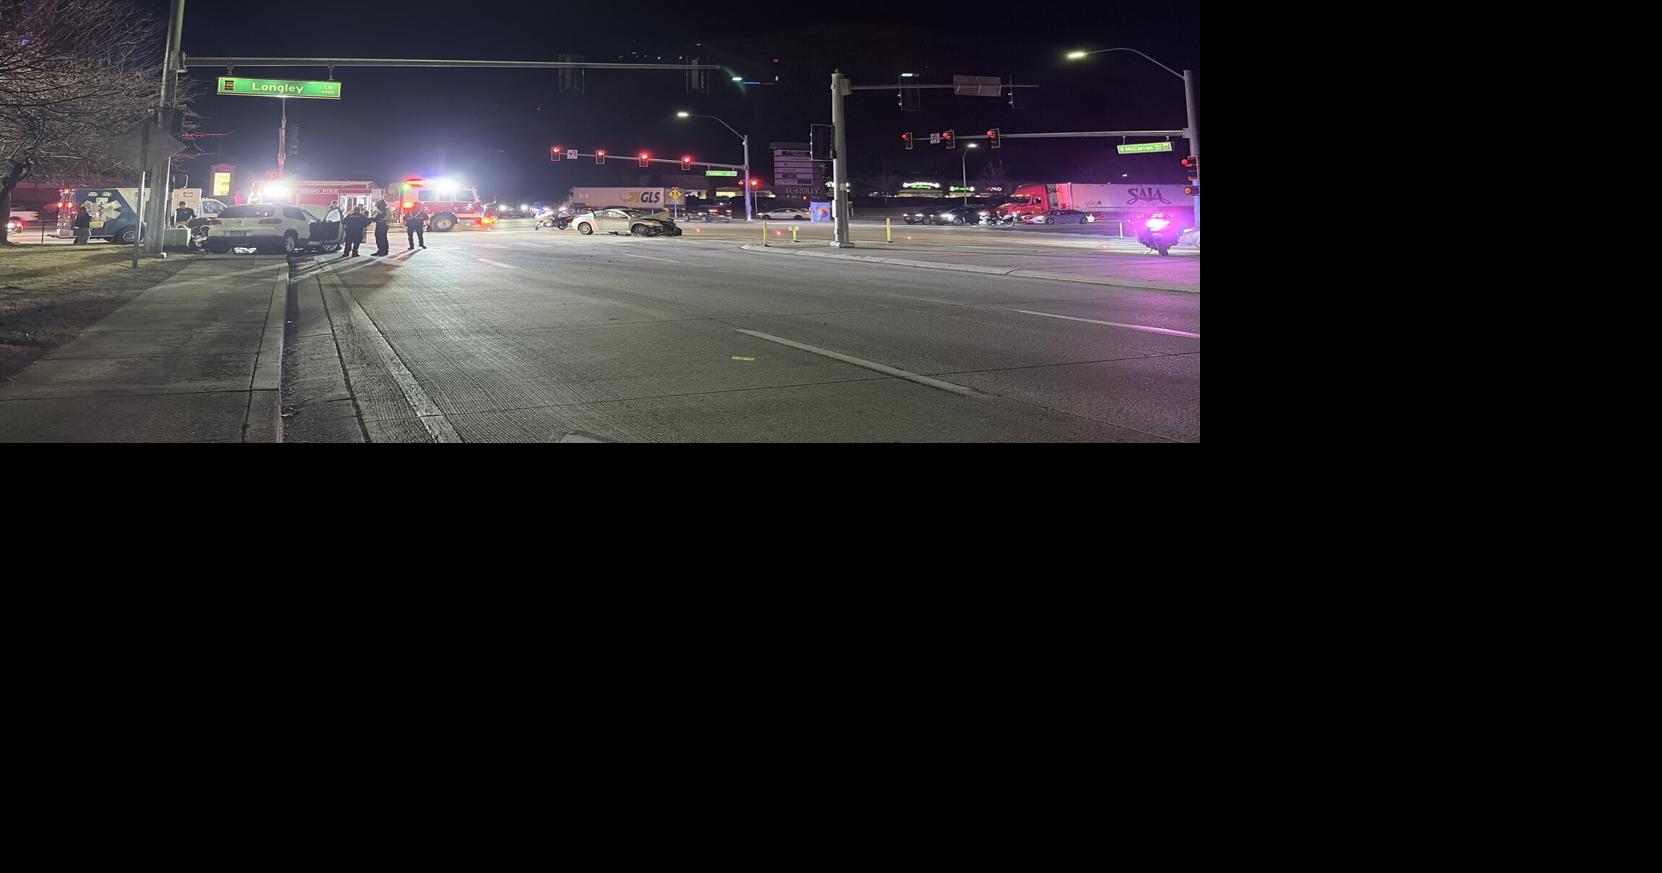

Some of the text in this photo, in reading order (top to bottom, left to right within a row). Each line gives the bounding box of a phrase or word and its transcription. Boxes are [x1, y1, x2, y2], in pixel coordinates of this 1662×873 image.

[252, 82, 304, 94] Longley
[640, 191, 660, 203] GLS
[1127, 187, 1166, 202] SAIA
